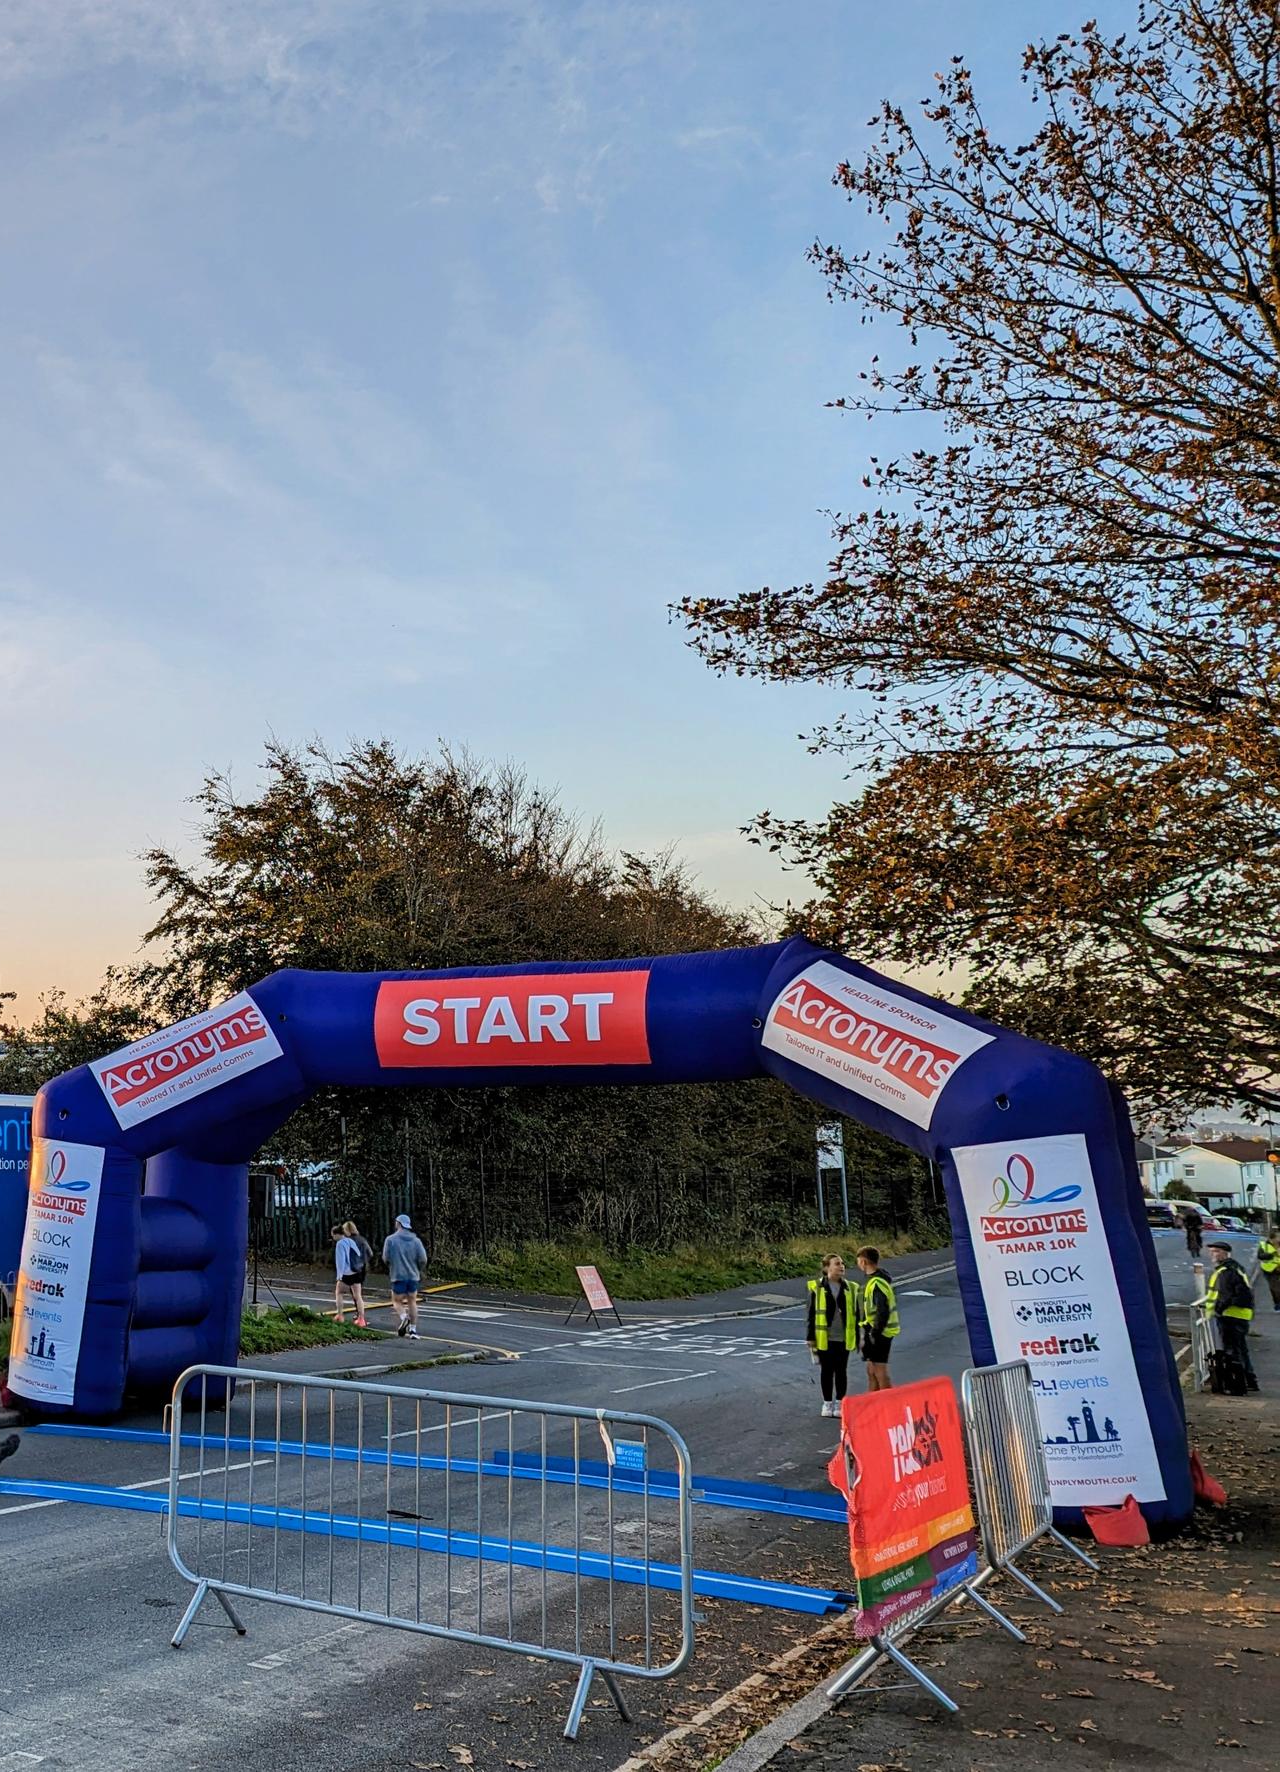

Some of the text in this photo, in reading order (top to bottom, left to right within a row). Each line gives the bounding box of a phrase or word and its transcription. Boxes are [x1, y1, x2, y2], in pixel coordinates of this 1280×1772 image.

[840, 985, 937, 1031] HEADLINE SPONSOR
[402, 992, 614, 1046] START
[129, 1014, 214, 1055] HEADLINE SPONSOR
[779, 984, 954, 1087] Acronyms
[105, 1010, 266, 1092] Acronyms
[785, 1033, 907, 1101] Tailored IT and Unified Comms
[136, 1049, 254, 1108] Tailored IT and Unified Comms
[58, 1214, 74, 1225] 10K
[981, 1213, 1088, 1235] Acronyms
[32, 1229, 71, 1248] BLOCK
[997, 1238, 1076, 1254] TAMAR 10K
[36, 1264, 68, 1275] UNIVERSITY
[38, 1257, 69, 1270] MARJON
[1004, 1265, 1084, 1287] BLOCK
[1034, 1302, 1092, 1316] MARJON
[1037, 1312, 1093, 1324] UNIVERSITY
[637, 1333, 807, 1346] KEEP
[1020, 1333, 1100, 1356] redrok
[1059, 1375, 1109, 1390] events
[1045, 1445, 1067, 1455] One
[1071, 1443, 1123, 1456] Plymouth
